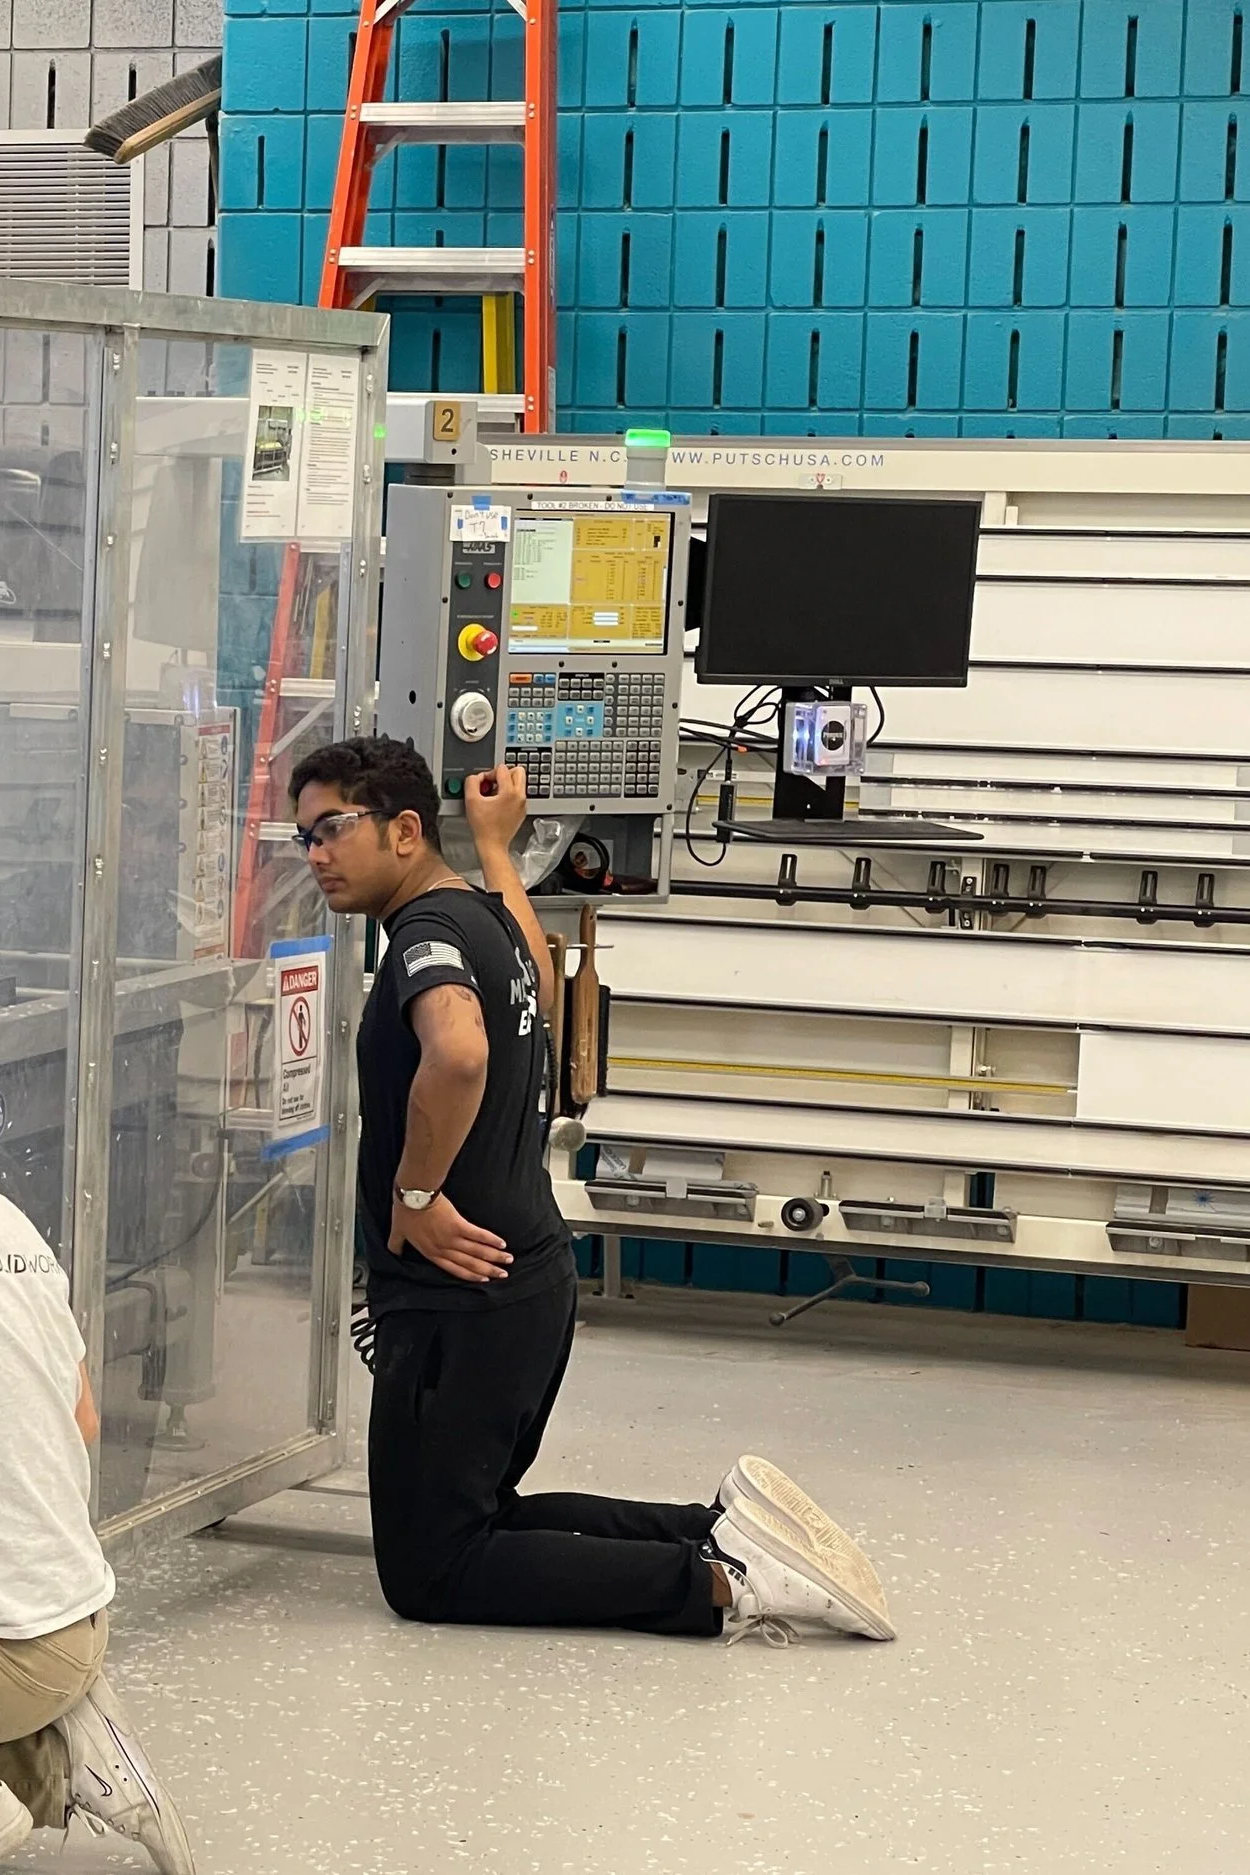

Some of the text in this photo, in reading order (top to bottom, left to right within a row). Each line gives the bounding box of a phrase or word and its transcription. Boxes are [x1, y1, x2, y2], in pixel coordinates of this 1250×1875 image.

[440, 408, 454, 432] 2
[490, 449, 578, 462] SHEVILLE
[671, 452, 885, 467] WW.PUTSCHUSA.COM
[568, 502, 598, 510] BROKEN
[289, 971, 317, 990] DANGER
